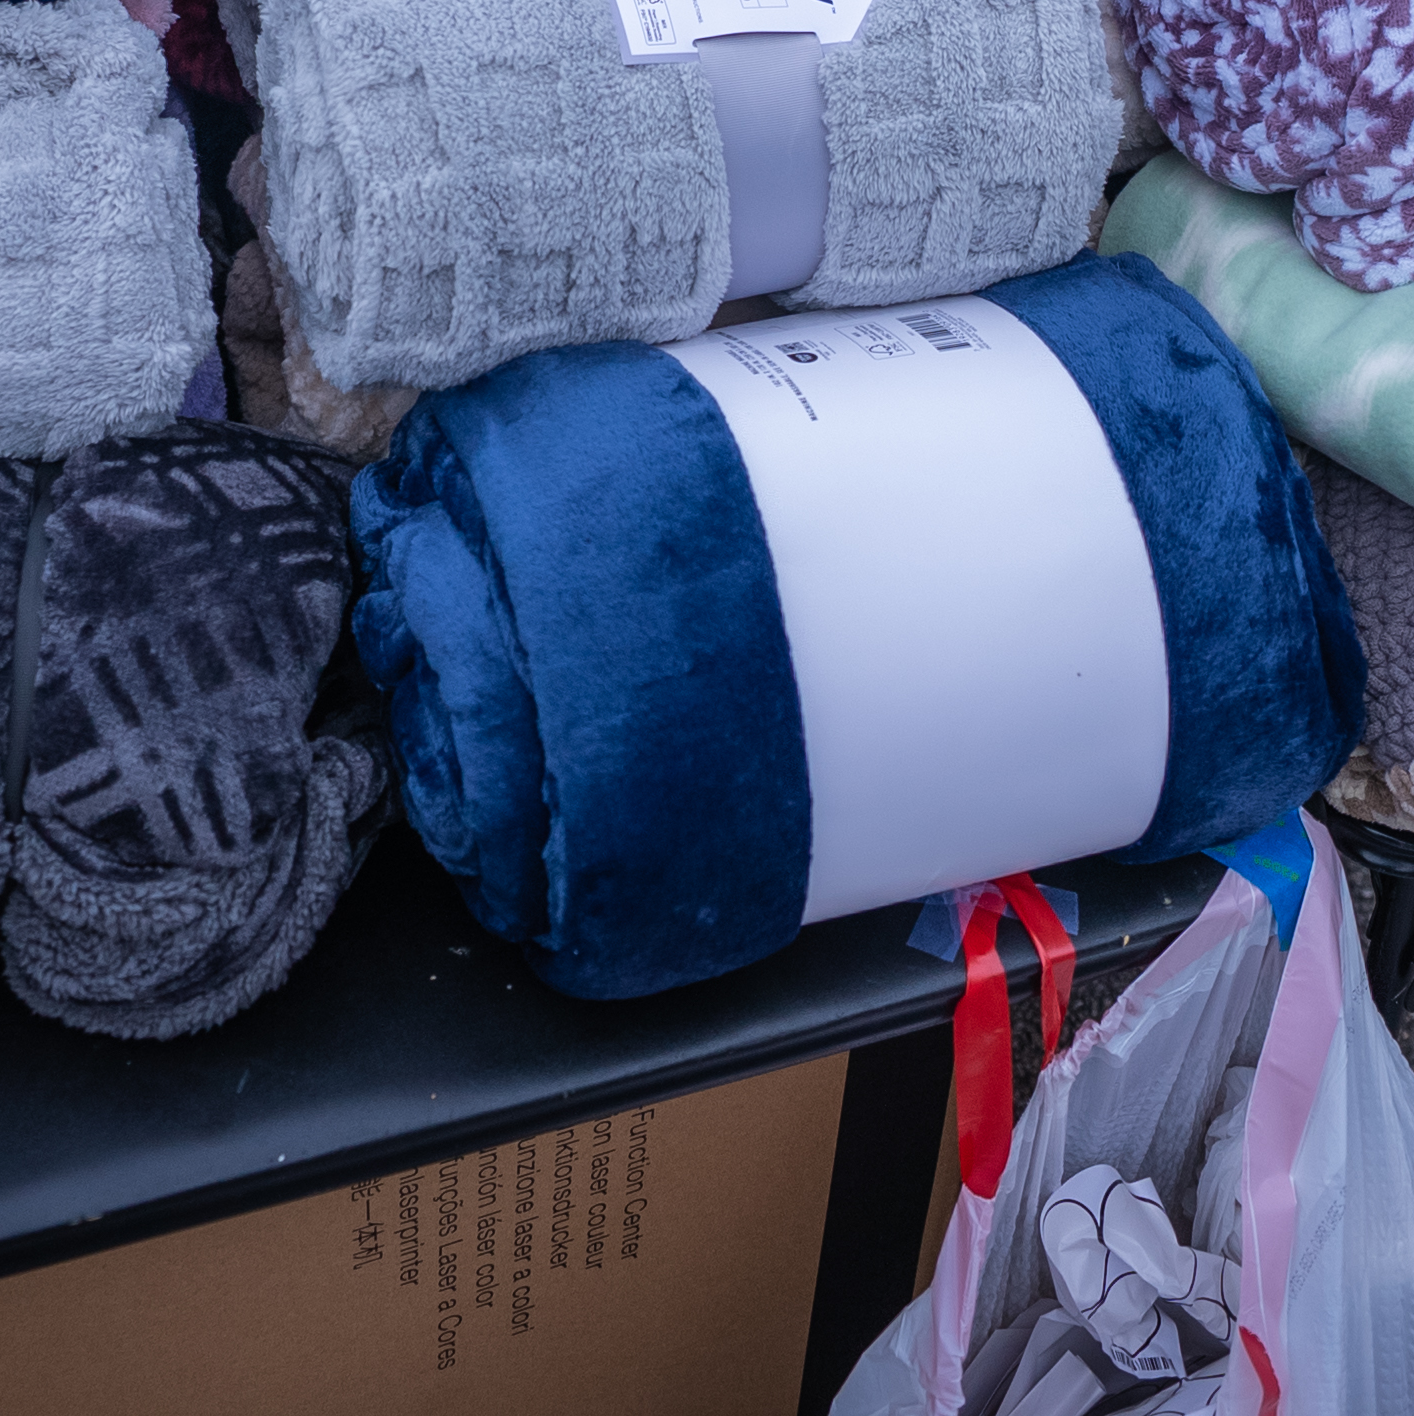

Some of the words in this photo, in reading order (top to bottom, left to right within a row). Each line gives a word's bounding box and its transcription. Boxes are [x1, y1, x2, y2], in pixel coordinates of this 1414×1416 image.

[798, 396, 818, 421] MACHINE
[590, 1148, 615, 1196] laser
[476, 1209, 502, 1256] láser
[513, 1216, 538, 1262] laser
[584, 1203, 609, 1270] couleur
[620, 1198, 647, 1261] Center
[438, 1239, 462, 1291] Laser
[475, 1263, 498, 1309] color
[514, 1269, 531, 1281] a
[439, 1299, 456, 1312] a
[509, 1285, 534, 1335] colori
[437, 1314, 461, 1370] Cores
